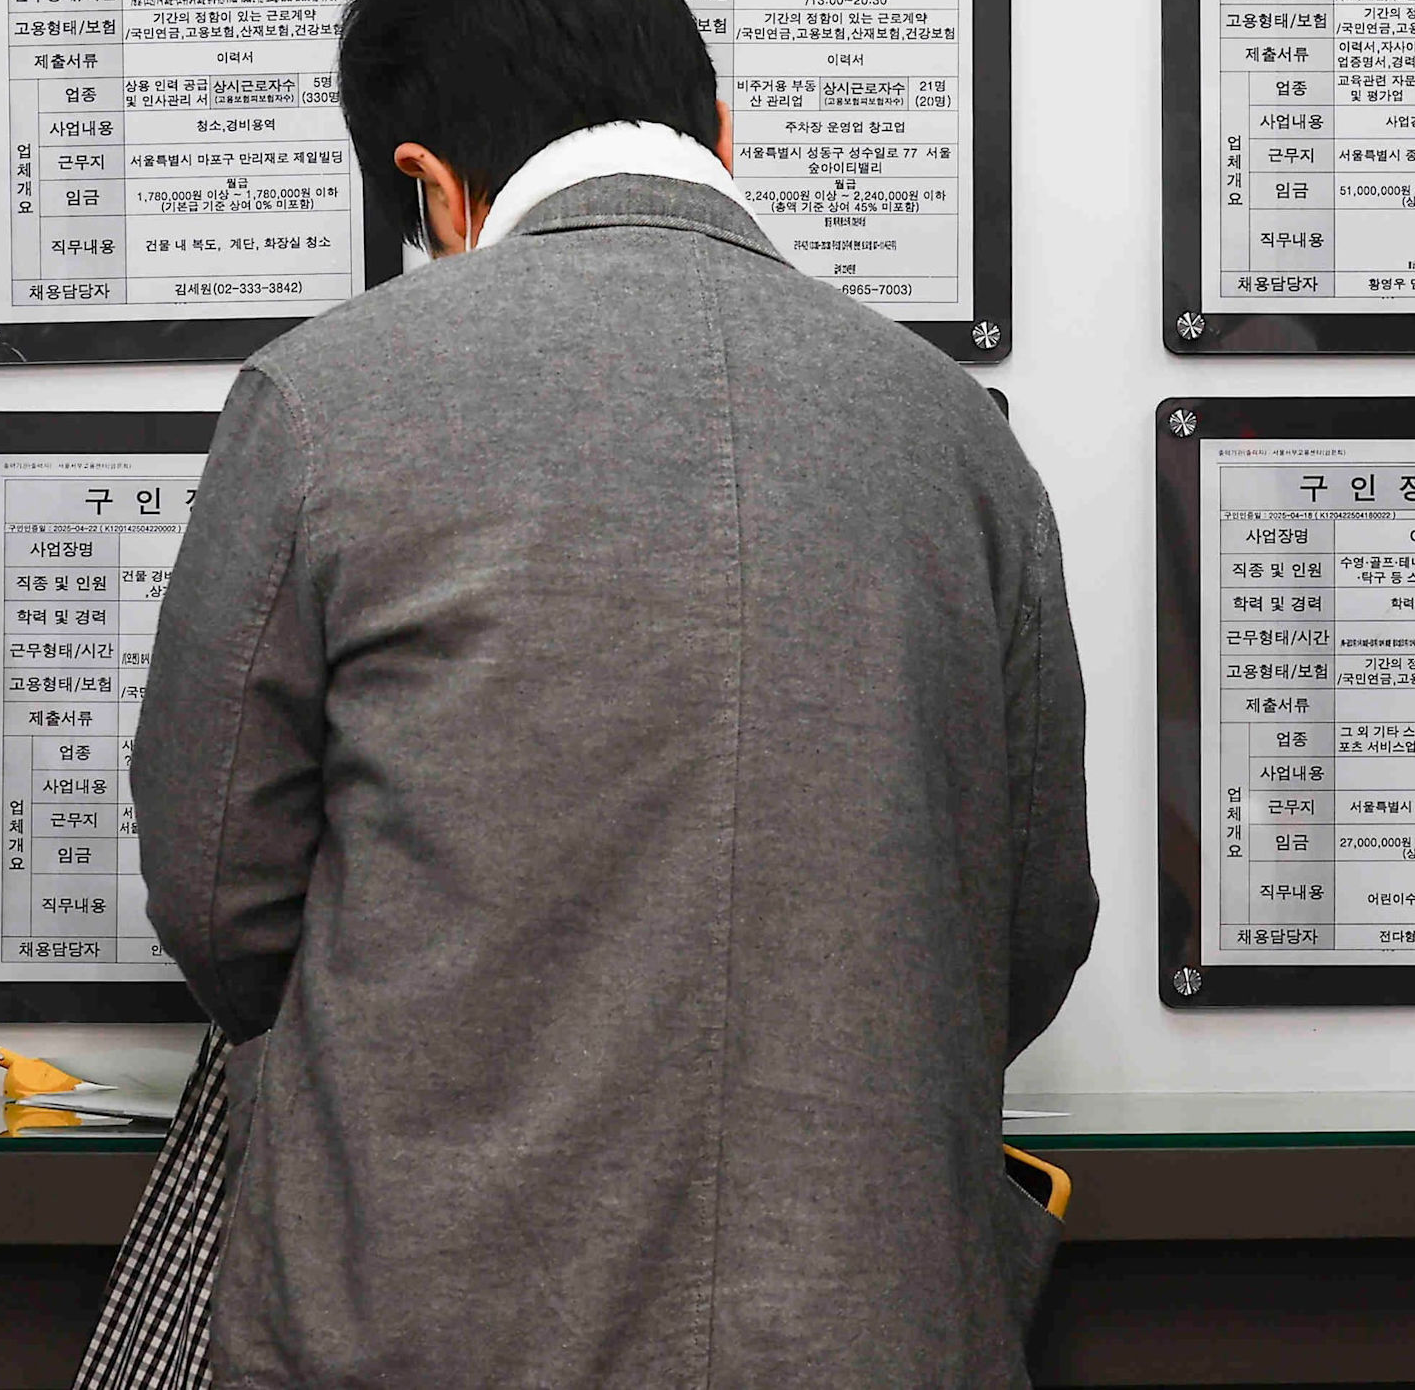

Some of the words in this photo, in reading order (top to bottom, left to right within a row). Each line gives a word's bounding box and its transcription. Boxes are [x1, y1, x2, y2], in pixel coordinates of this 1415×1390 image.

[1225, 12, 1327, 30] 고용형태/보험
[737, 79, 787, 93] 비주거용
[919, 79, 946, 93] 21명
[785, 121, 824, 134] 주차장
[826, 121, 863, 134] 운영업
[868, 121, 905, 135] 창고업
[197, 153, 235, 166] 마포구
[239, 152, 290, 165] 만리재로
[293, 150, 343, 164] 제일빌딩
[806, 146, 845, 160] 성동구
[848, 146, 899, 160] 성수일로
[902, 147, 918, 159] 77
[263, 236, 301, 250] 화장실
[305, 235, 331, 249] 청소
[29, 541, 93, 558] 사업장명
[9, 642, 114, 660] 근무형태/시간
[1339, 836, 1412, 849] 27,000,000원
[41, 897, 107, 914] 직무내용
